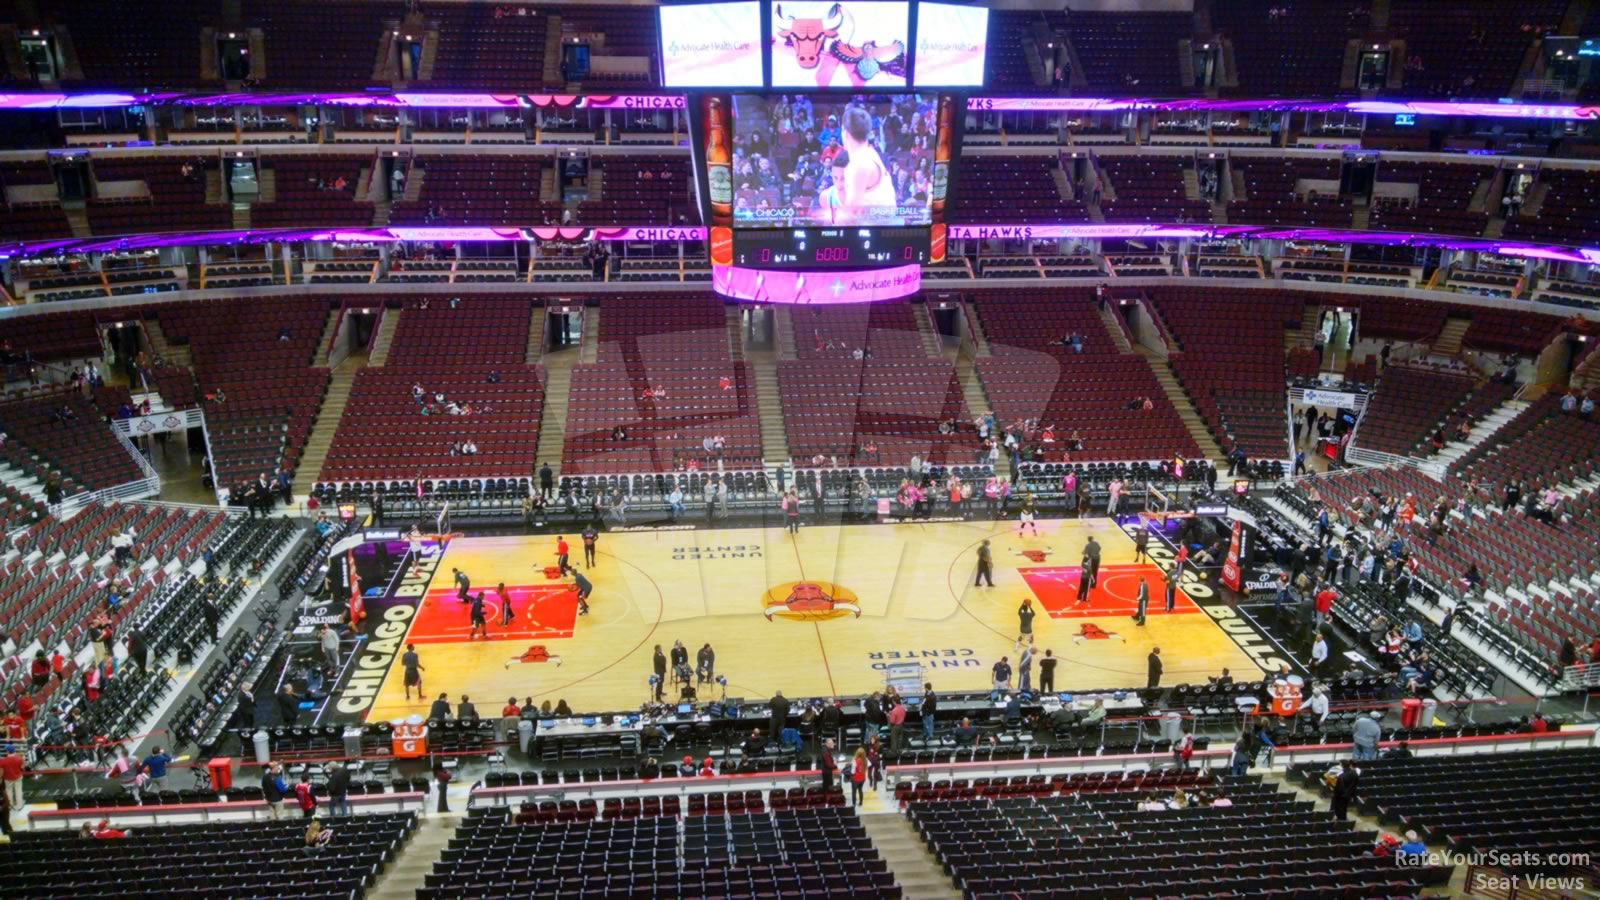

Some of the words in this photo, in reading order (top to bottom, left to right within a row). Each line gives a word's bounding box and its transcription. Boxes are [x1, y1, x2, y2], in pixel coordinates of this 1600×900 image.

[711, 41, 732, 51] Health
[734, 41, 750, 50] Care
[756, 208, 794, 216] CHICAGO
[980, 227, 1032, 238] HAWKS
[850, 279, 892, 291] Advocate
[1318, 392, 1345, 400] Advocate
[672, 545, 760, 553] CENTER
[672, 552, 762, 560] UNITED
[1202, 606, 1292, 672] BULLS
[336, 604, 414, 714] CHICAGO
[868, 648, 974, 659] CENTER
[872, 659, 980, 670] UNID
[1282, 700, 1292, 711] G
[403, 740, 415, 752] G
